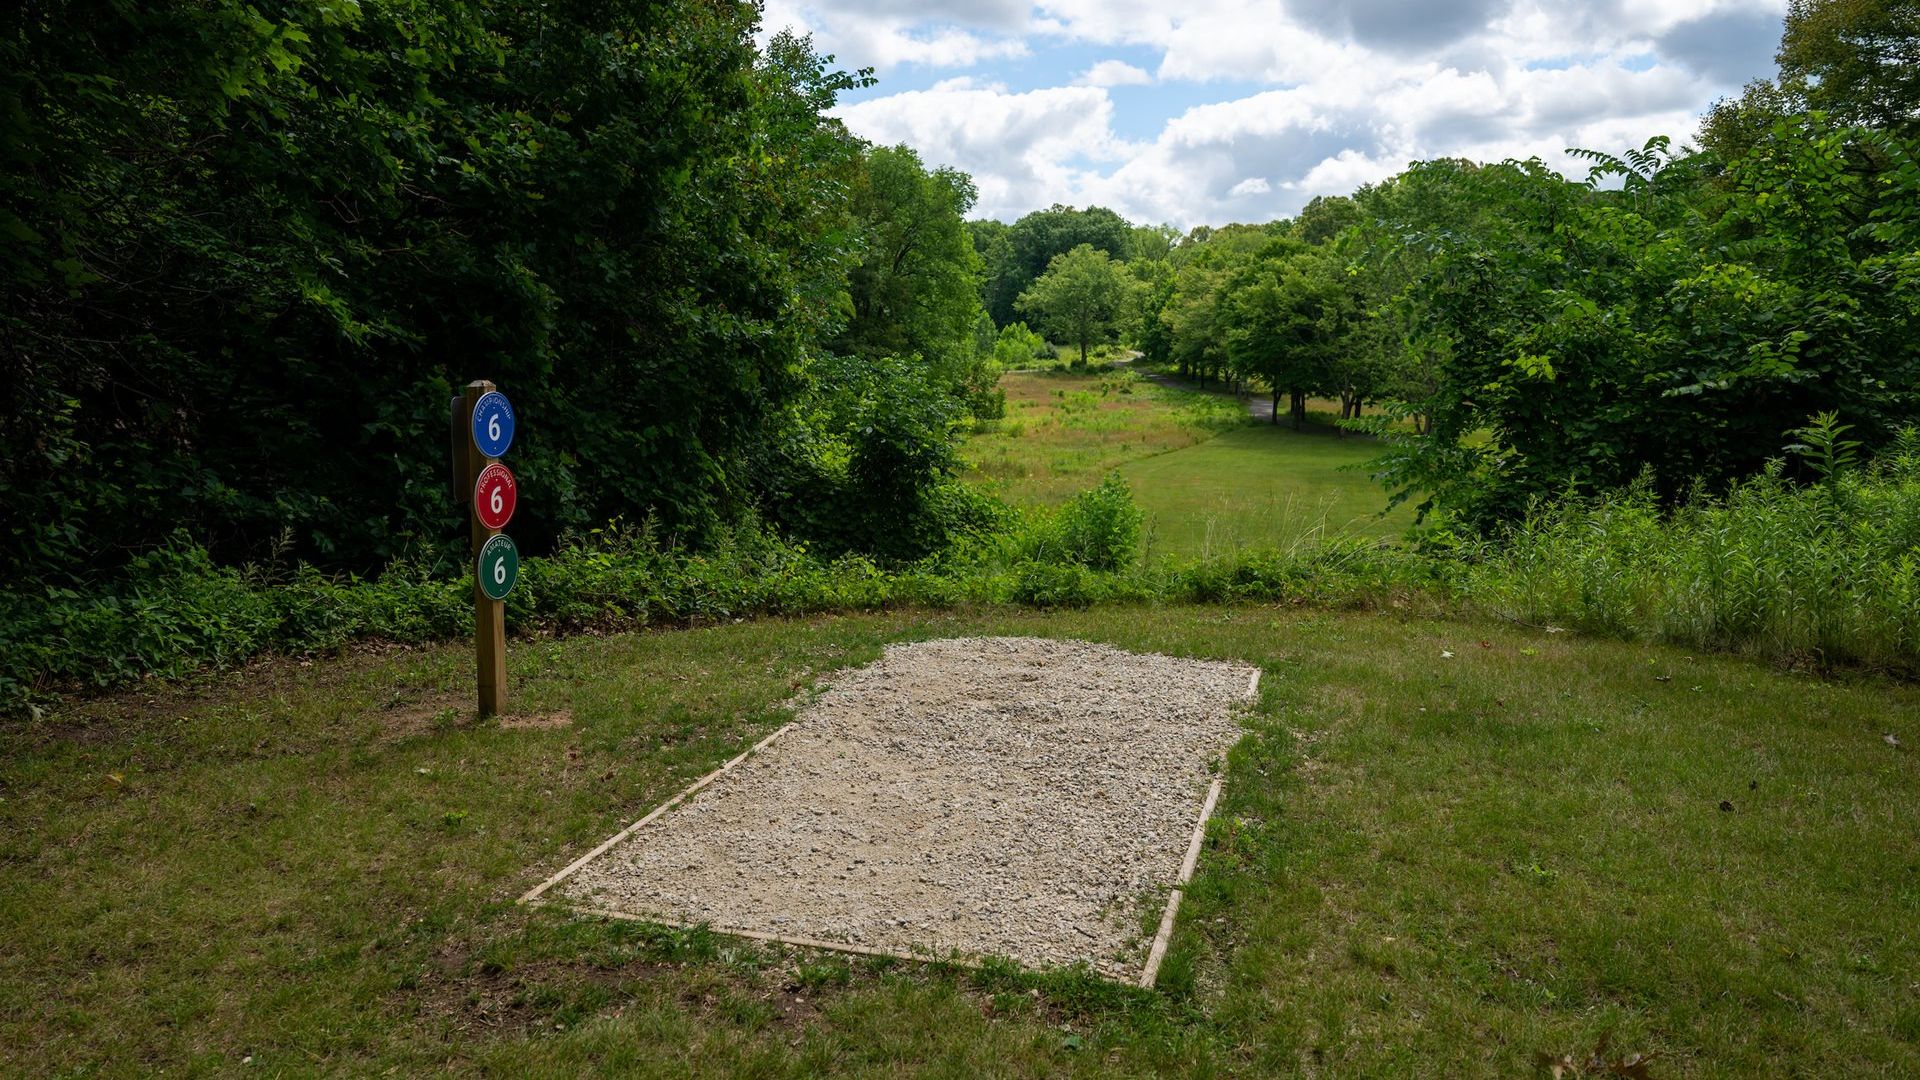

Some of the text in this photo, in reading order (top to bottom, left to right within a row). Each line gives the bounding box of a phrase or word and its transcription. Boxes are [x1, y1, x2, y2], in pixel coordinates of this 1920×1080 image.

[477, 396, 512, 422] CHAMPIONSHIP
[488, 413, 501, 441] 6
[480, 468, 513, 494] PROFESSIONAL
[491, 485, 503, 514] 6
[487, 539, 512, 556] AMATEUR
[494, 556, 506, 584] 6
